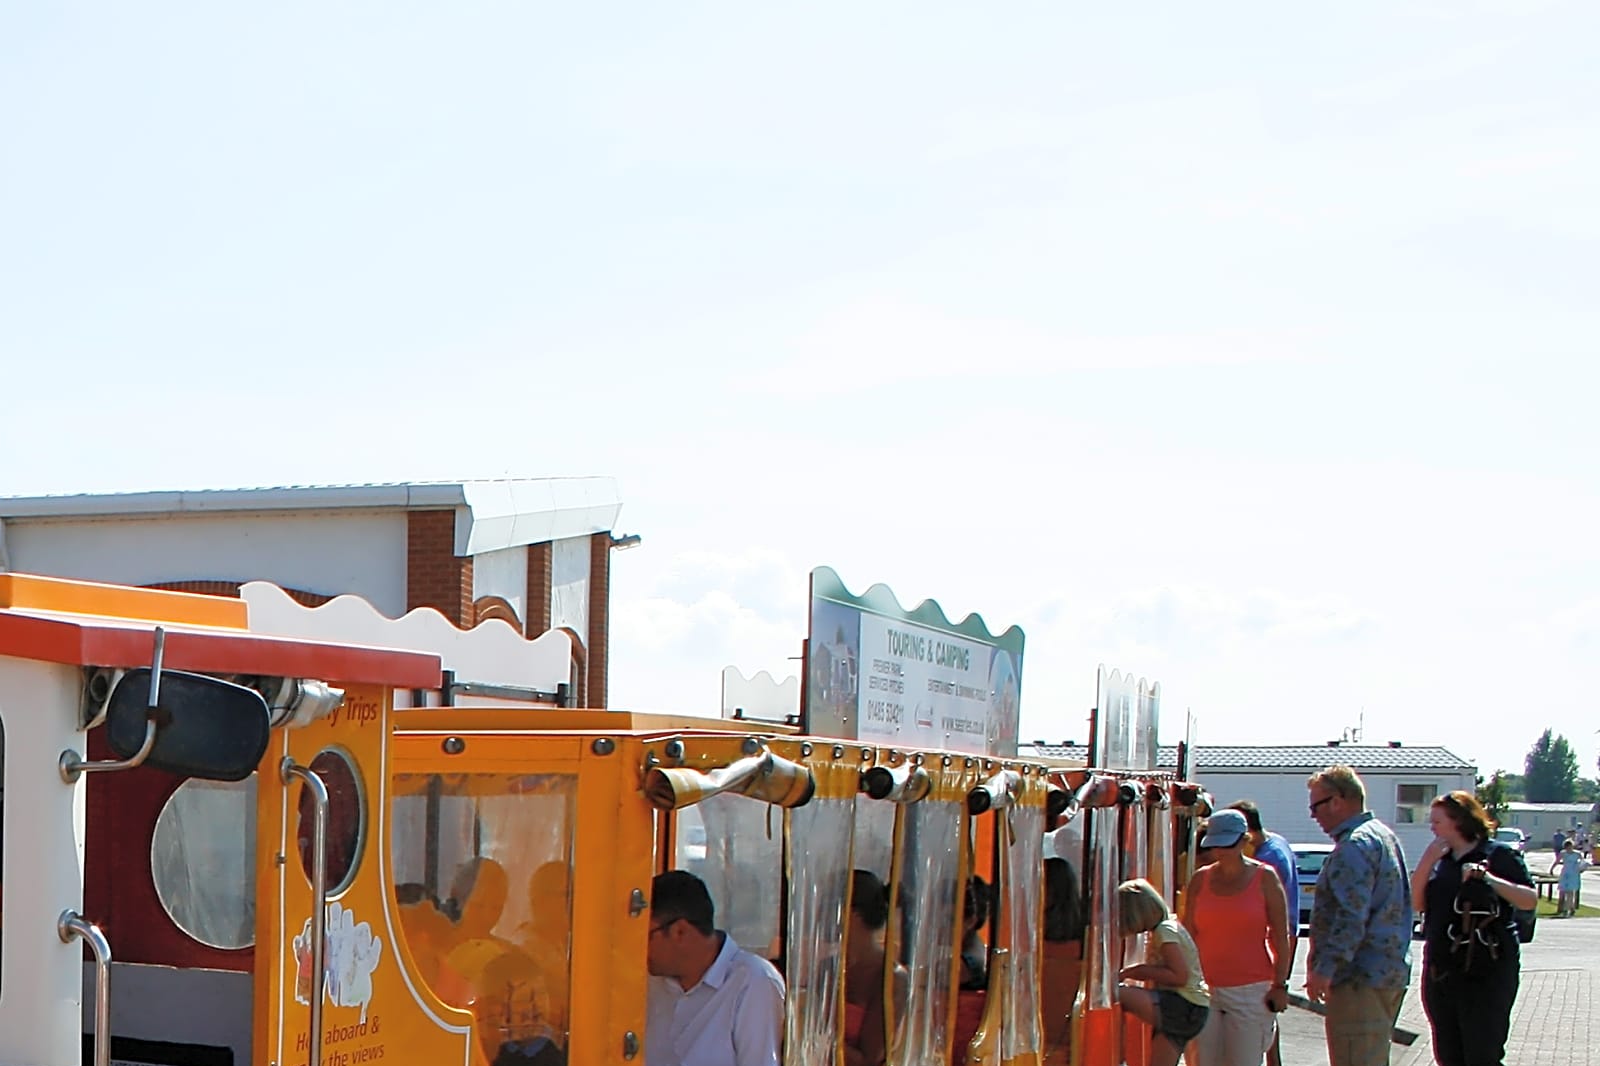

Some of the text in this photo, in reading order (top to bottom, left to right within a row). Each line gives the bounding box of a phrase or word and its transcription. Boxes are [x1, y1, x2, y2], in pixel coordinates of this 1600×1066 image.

[887, 629, 970, 672] TOURING & CAMPING
[346, 696, 377, 727] Trips
[324, 1016, 368, 1046] aboard
[370, 1015, 381, 1035] &
[351, 1043, 385, 1065] views
